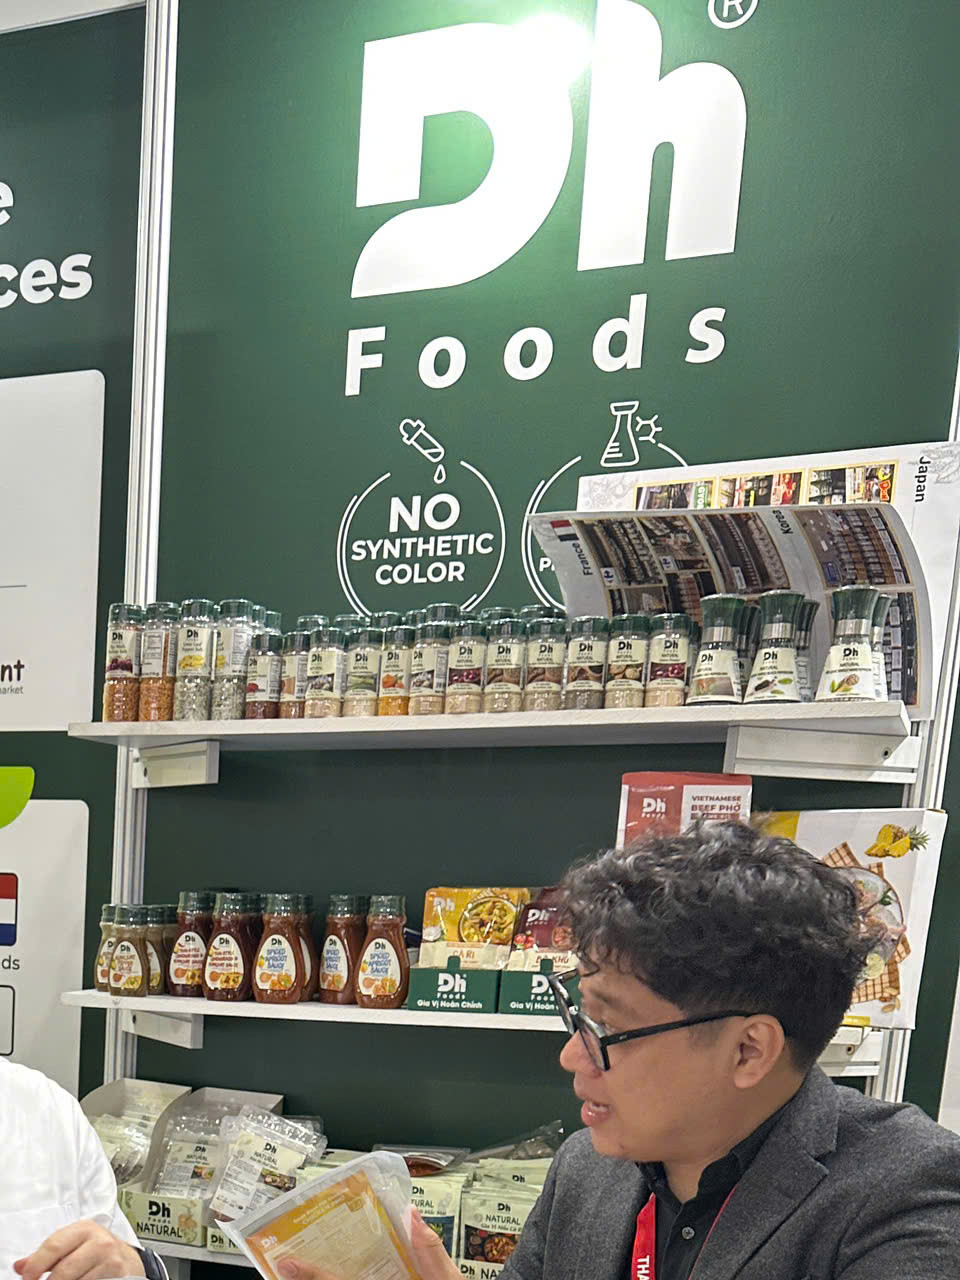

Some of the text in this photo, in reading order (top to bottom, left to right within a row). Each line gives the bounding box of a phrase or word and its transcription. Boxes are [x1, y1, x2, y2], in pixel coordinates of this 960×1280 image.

[351, 0, 747, 298] Dh
[345, 293, 726, 396] Foods
[915, 455, 926, 503] Japan
[388, 494, 461, 533] NO
[772, 509, 795, 535] Korea
[351, 533, 494, 562] SYNTHETIC
[573, 542, 594, 575] France
[375, 561, 465, 586] COLOR
[643, 798, 666, 812] Dh
[438, 973, 467, 992] Dh
[532, 974, 552, 994] D
[264, 1143, 277, 1154] Dh
[148, 1200, 171, 1218] Dh
[498, 1203, 511, 1211] Dh
[486, 1215, 520, 1225] NATURAL
[137, 1222, 182, 1239] NATURAL
[211, 1234, 224, 1244] Dh
[460, 1265, 475, 1275] Dh
